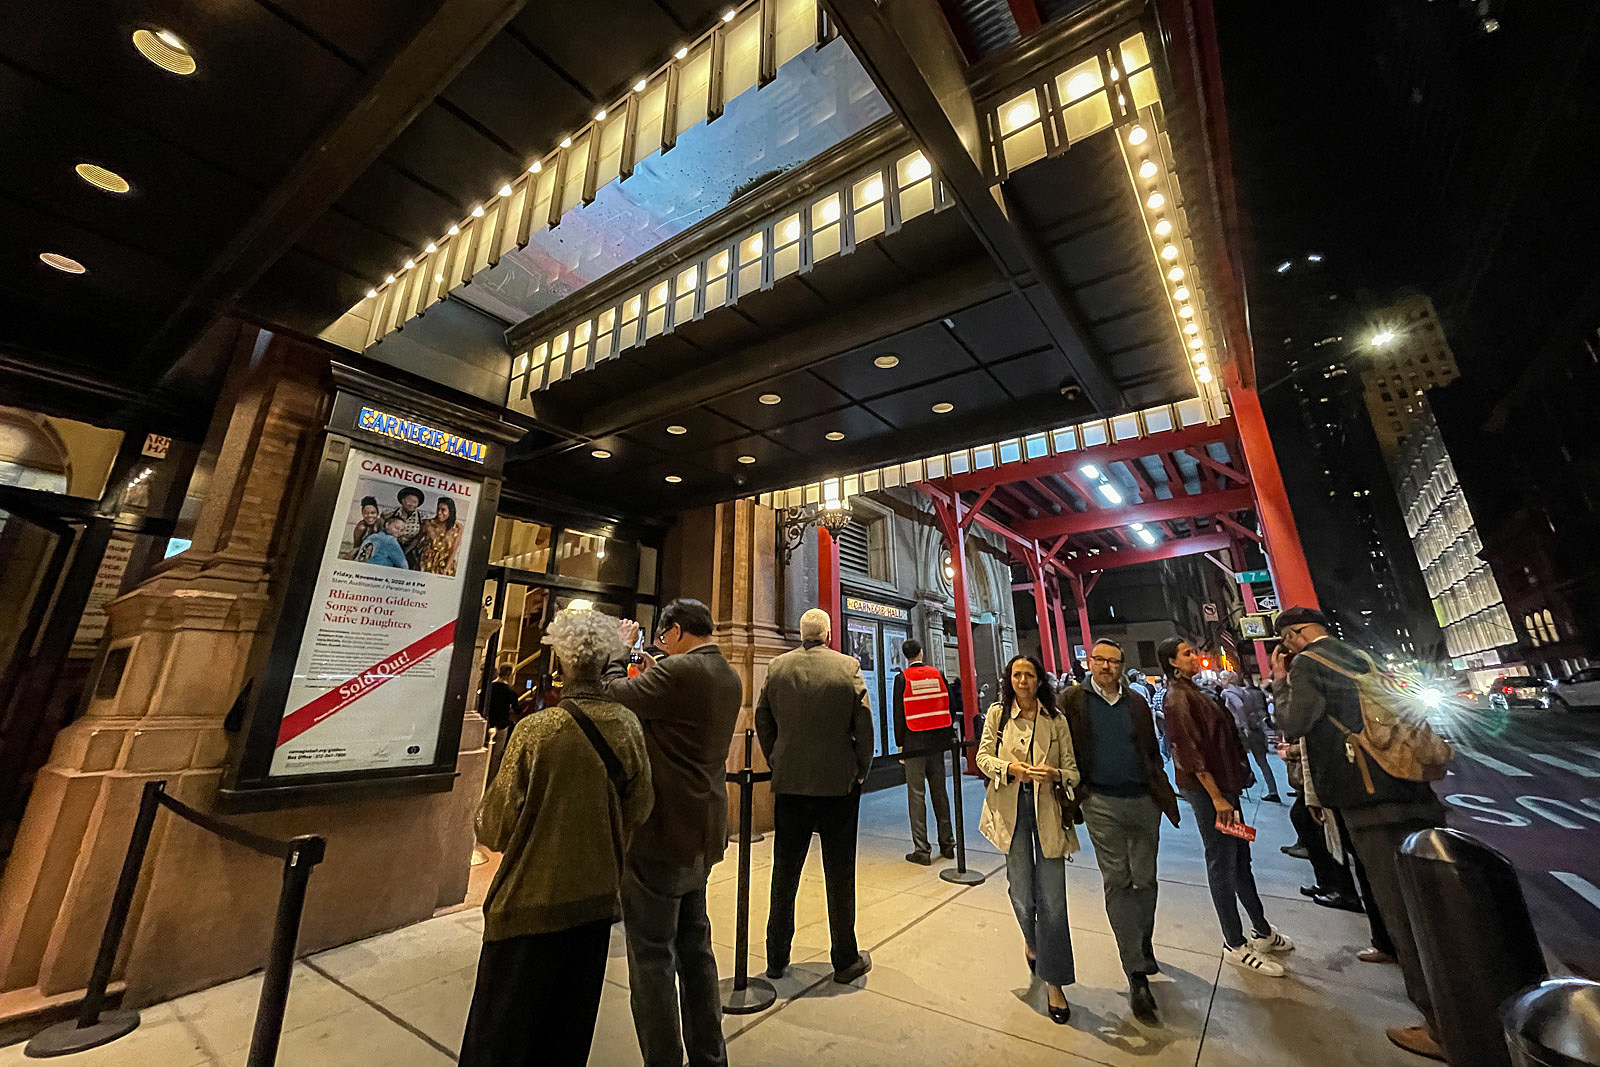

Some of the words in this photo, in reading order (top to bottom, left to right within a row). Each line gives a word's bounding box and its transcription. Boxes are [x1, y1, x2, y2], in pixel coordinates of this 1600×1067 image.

[358, 408, 445, 449] CARNEGIE
[446, 433, 486, 463] HALL
[360, 459, 436, 489] CARNEGIE
[437, 478, 472, 498] HALL
[331, 577, 348, 585] Stern
[349, 579, 381, 589] Auditorium
[385, 584, 411, 593] Perelman
[412, 587, 427, 596] Stage
[333, 570, 353, 579] Friday,
[355, 573, 384, 583] November
[391, 578, 405, 586] 2022
[1248, 573, 1256, 582] 7
[328, 588, 383, 604] Rhiannon
[385, 595, 429, 609] Giddens:
[325, 600, 358, 614] Songs
[360, 604, 372, 614] of
[374, 606, 395, 616] Our
[853, 601, 887, 615] CARNEGIE
[887, 607, 903, 618] HALL
[323, 613, 358, 625] Native
[360, 616, 412, 630] Daughters
[338, 672, 375, 700] Sold
[377, 651, 411, 677] Out!
